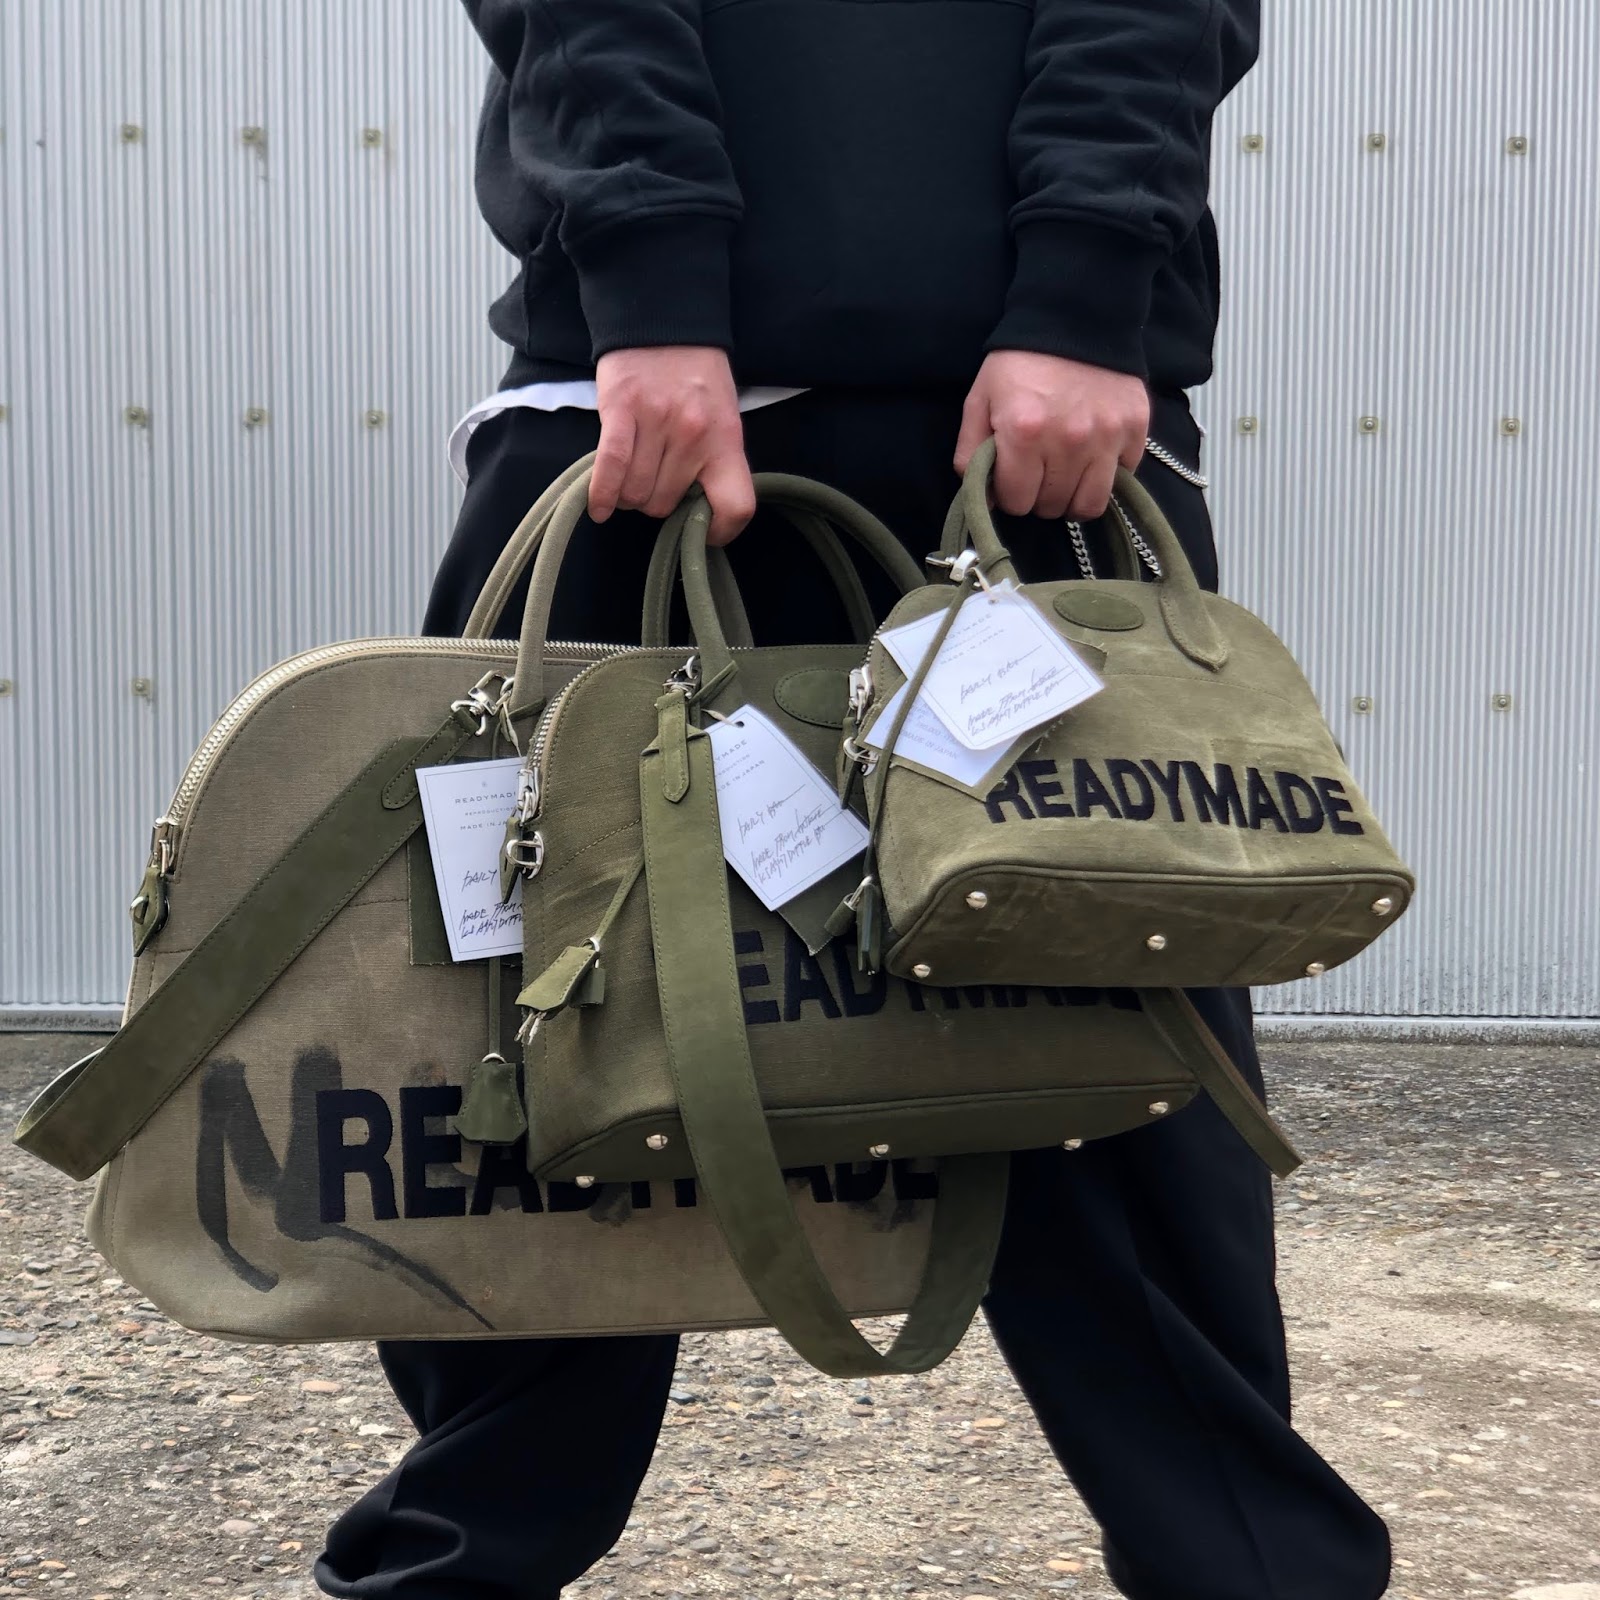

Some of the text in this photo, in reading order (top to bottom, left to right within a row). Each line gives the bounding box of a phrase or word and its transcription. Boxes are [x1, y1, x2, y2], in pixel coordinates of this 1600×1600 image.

[715, 740, 747, 761] YMADE
[985, 758, 1364, 836] READYMADE
[461, 869, 497, 892] DAILY
[459, 909, 490, 930] MADE
